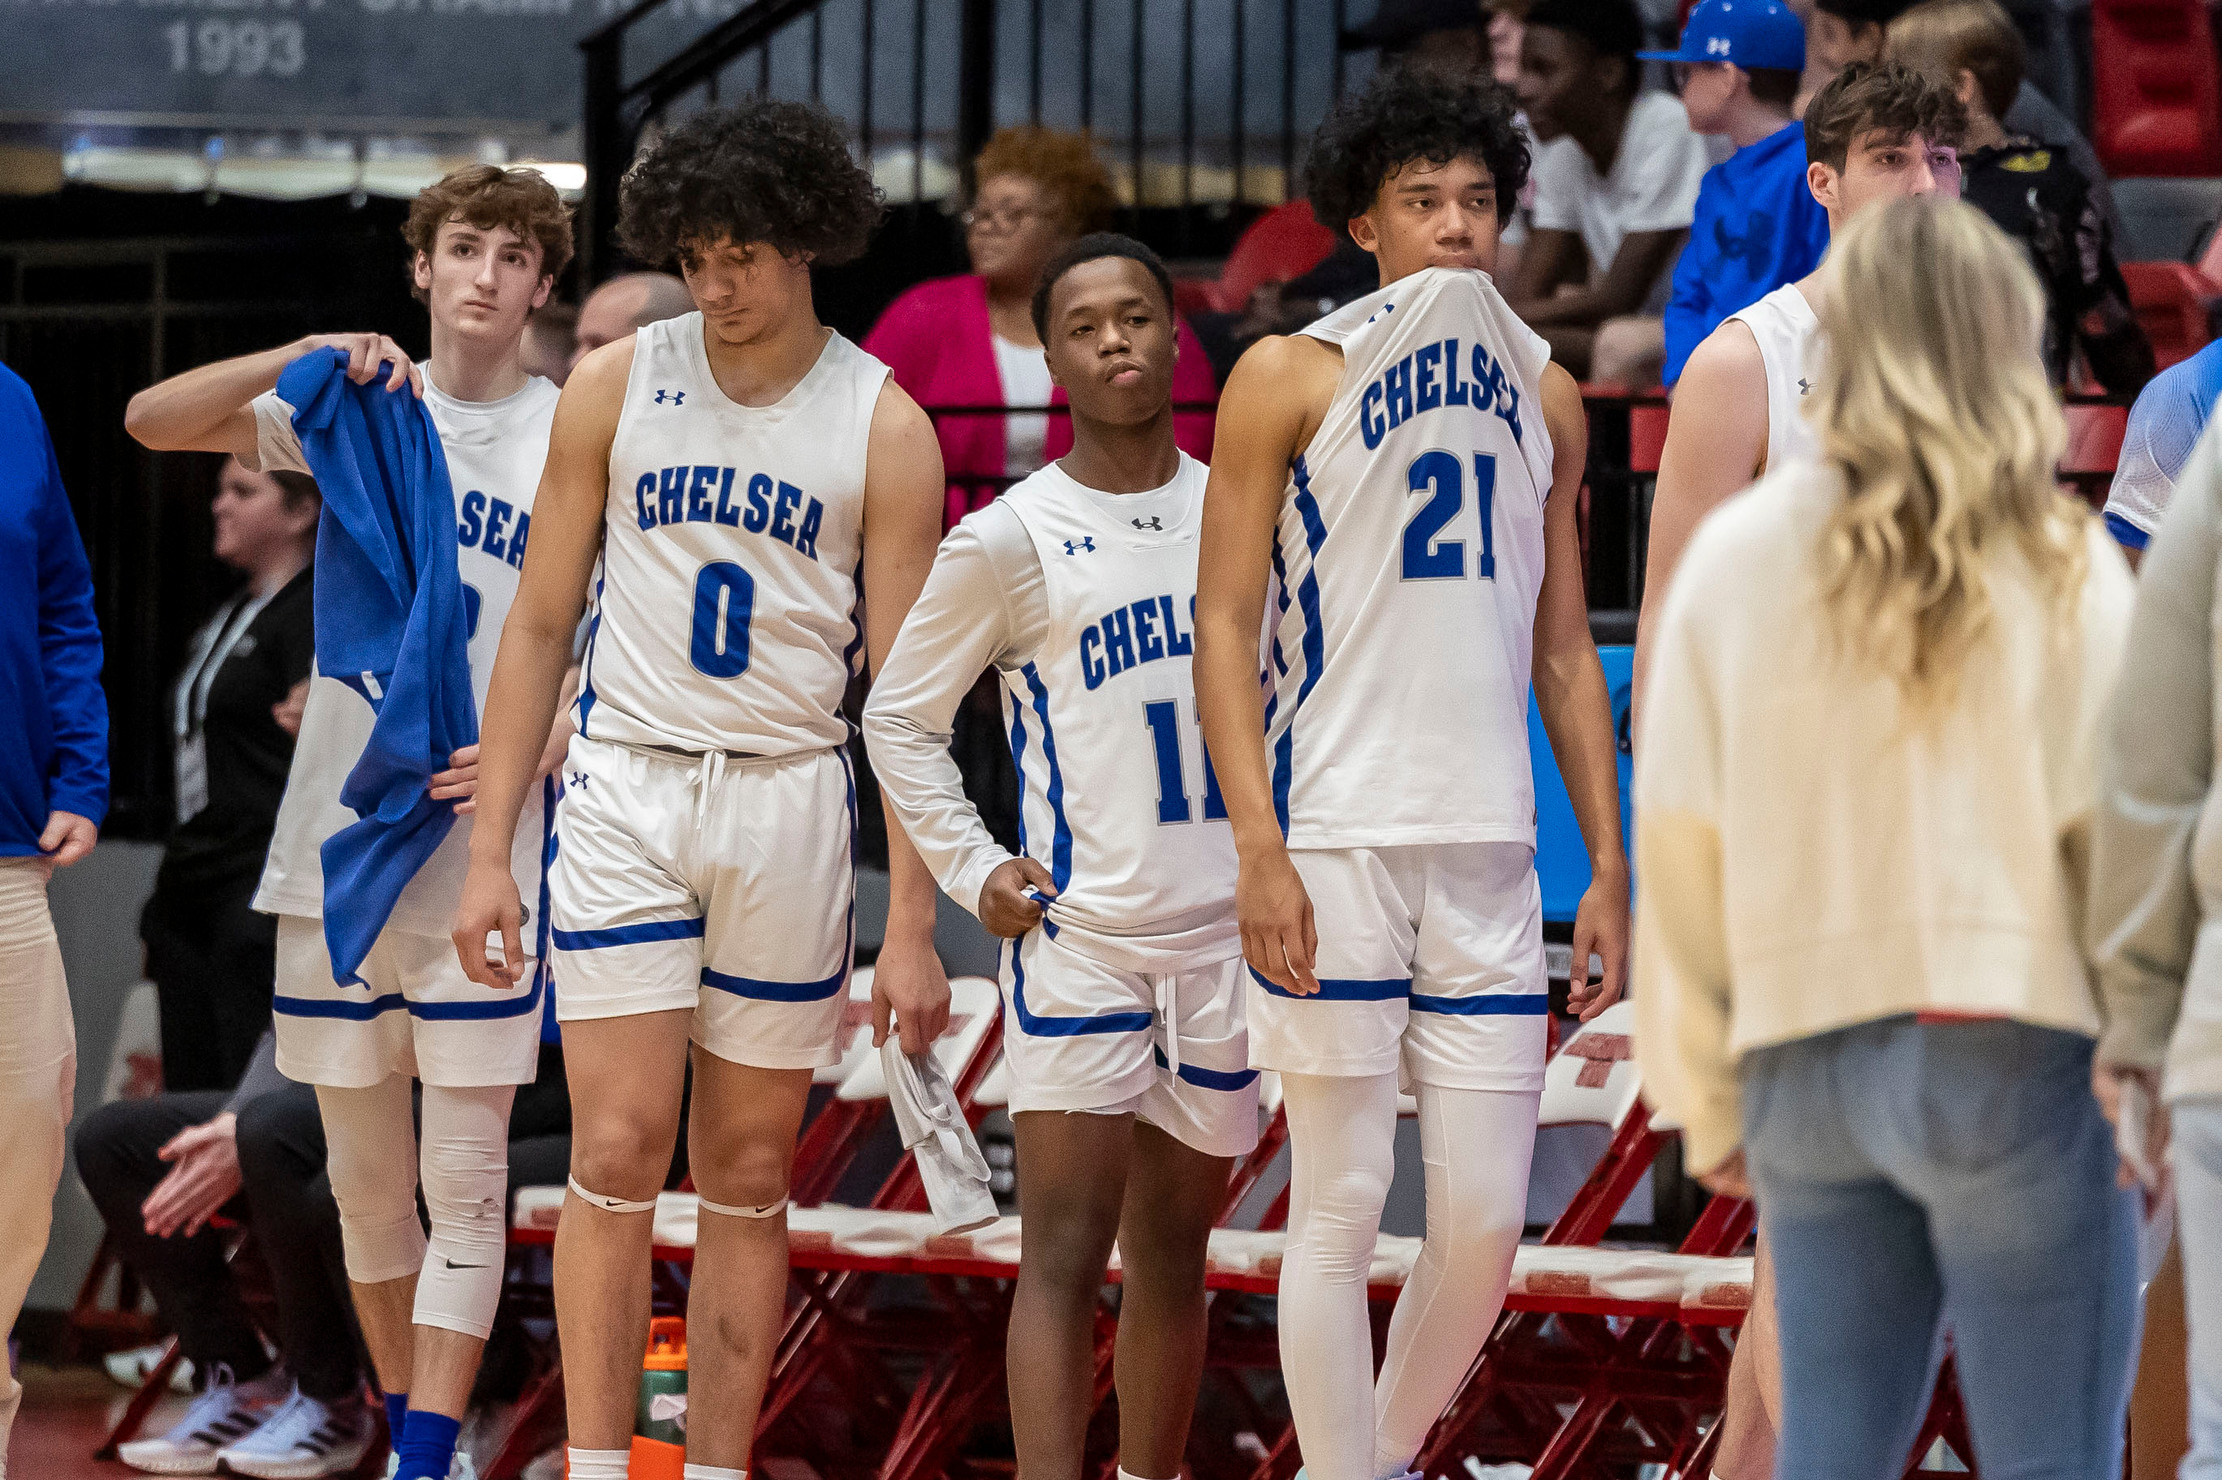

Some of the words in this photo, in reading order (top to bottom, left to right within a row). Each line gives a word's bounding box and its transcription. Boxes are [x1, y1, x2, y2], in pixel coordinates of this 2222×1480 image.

[165, 18, 305, 76] 1993
[1361, 338, 1523, 450] CHELSEA
[636, 465, 824, 562] CHELSEA
[1400, 447, 1498, 584] 21
[689, 559, 757, 680] 0
[1080, 593, 1197, 691] CHEL
